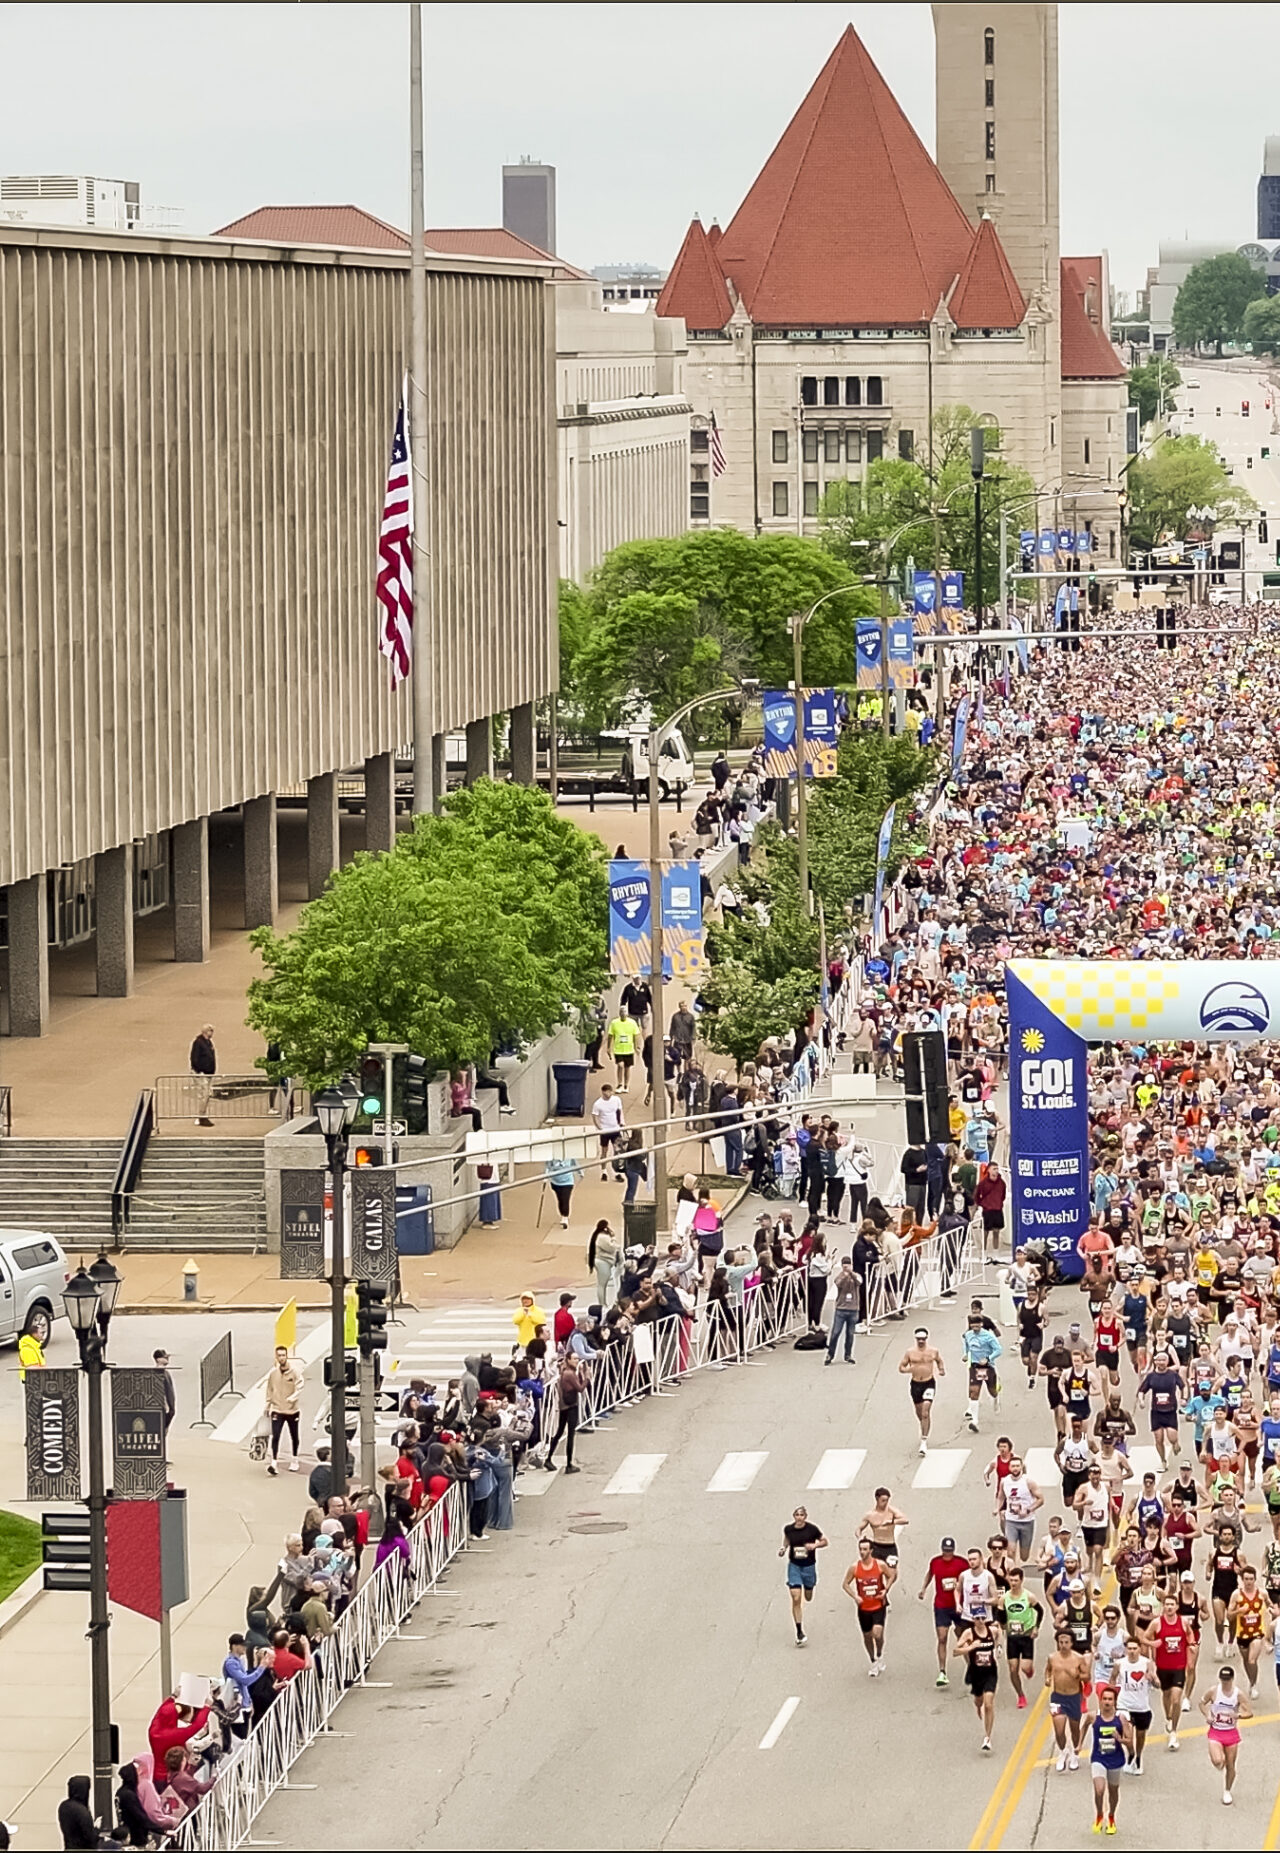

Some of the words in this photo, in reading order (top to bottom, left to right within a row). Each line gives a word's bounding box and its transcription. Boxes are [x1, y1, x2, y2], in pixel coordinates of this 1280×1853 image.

[611, 881, 649, 902] RHYTHM
[1021, 1058, 1074, 1095] GO!
[1022, 1094, 1036, 1110] St.
[1041, 1158, 1079, 1169] GREATER
[1034, 1208, 1079, 1224] WashU
[285, 1221, 321, 1233] STIFEL
[365, 1198, 383, 1251] GALAS
[42, 1397, 64, 1474] COMEDY
[118, 1433, 161, 1444] STIFEL
